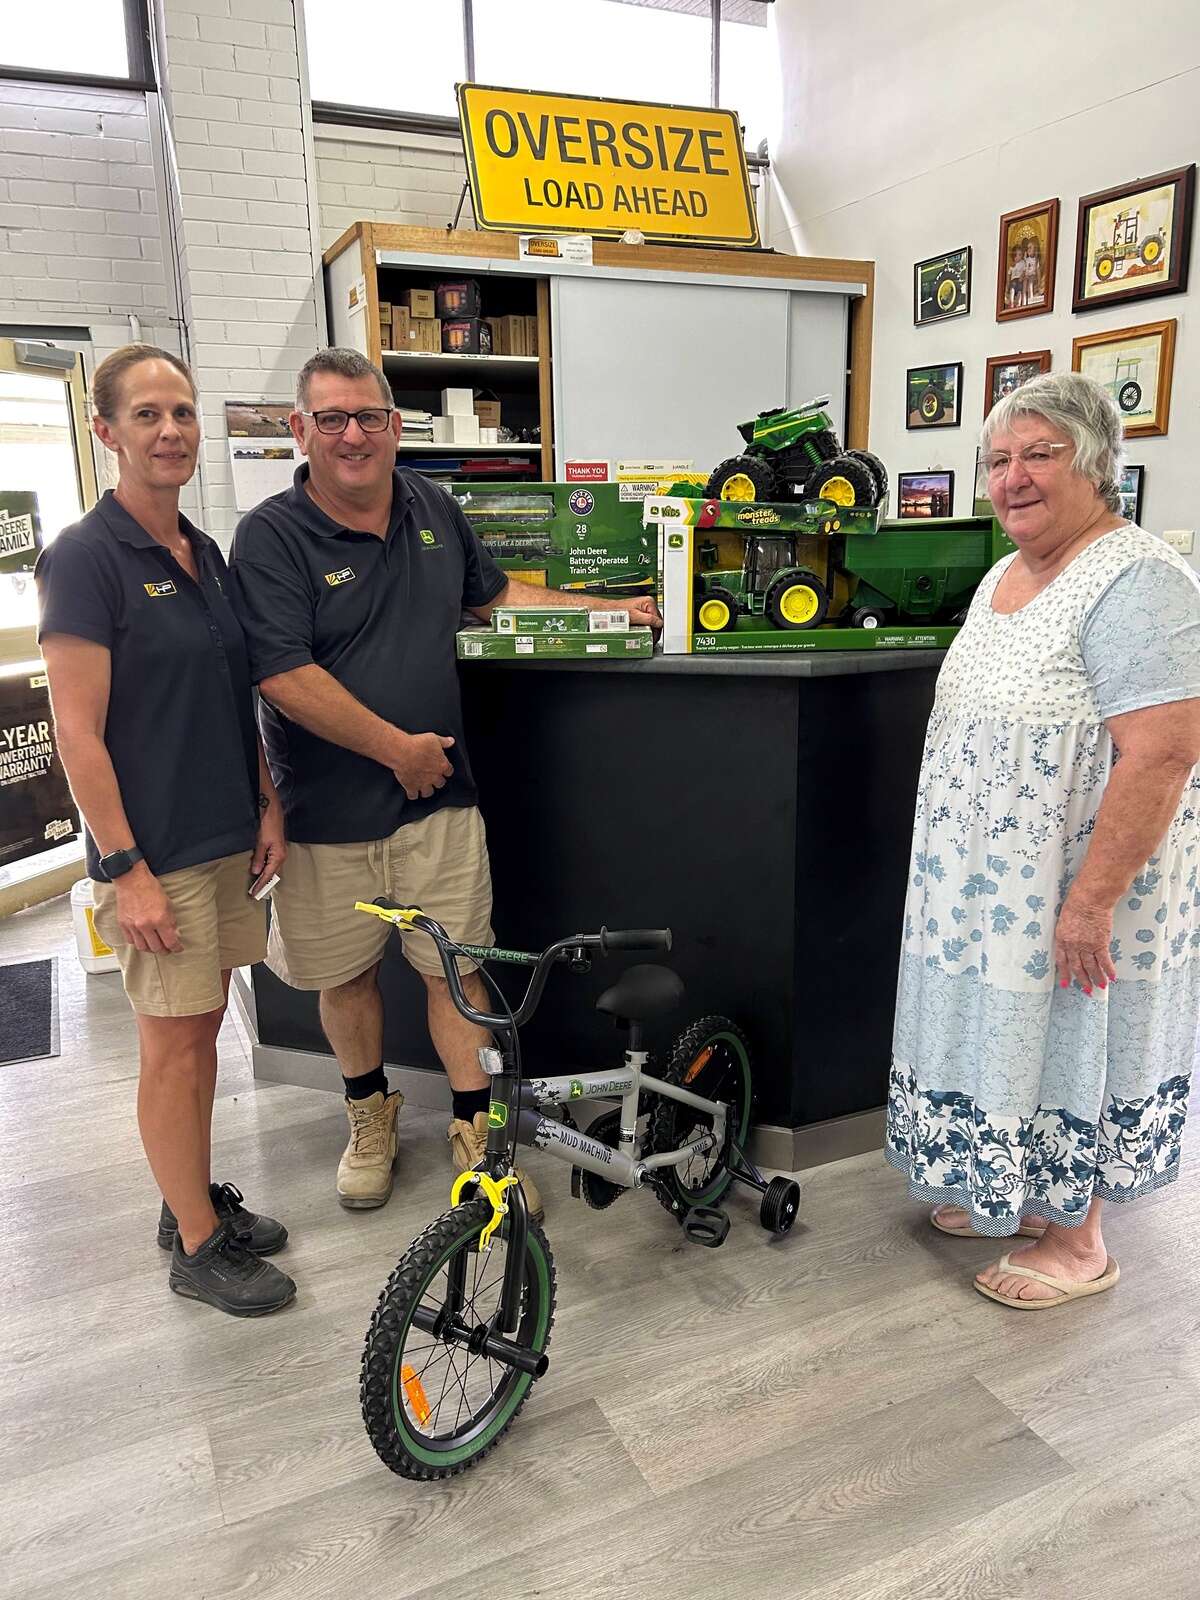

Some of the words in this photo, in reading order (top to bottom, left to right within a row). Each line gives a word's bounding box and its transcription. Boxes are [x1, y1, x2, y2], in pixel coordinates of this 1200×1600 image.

[485, 109, 729, 176] OVERSIZE
[523, 177, 603, 211] LOAD
[613, 184, 708, 218] AHEAD
[737, 510, 771, 520] monster
[751, 513, 780, 525] treads
[576, 524, 587, 533] 28
[569, 547, 586, 556] John
[587, 547, 607, 555] Deere
[569, 557, 596, 566] Battery
[596, 555, 629, 567] Operated
[569, 566, 587, 574] Train
[587, 566, 600, 574] Set
[696, 637, 716, 646] 7430
[490, 947, 529, 962] DEERE
[586, 1082, 609, 1095] JOHN
[609, 1080, 633, 1091] DEERE
[559, 1131, 578, 1148] MUD
[579, 1140, 613, 1164] MACHINE
